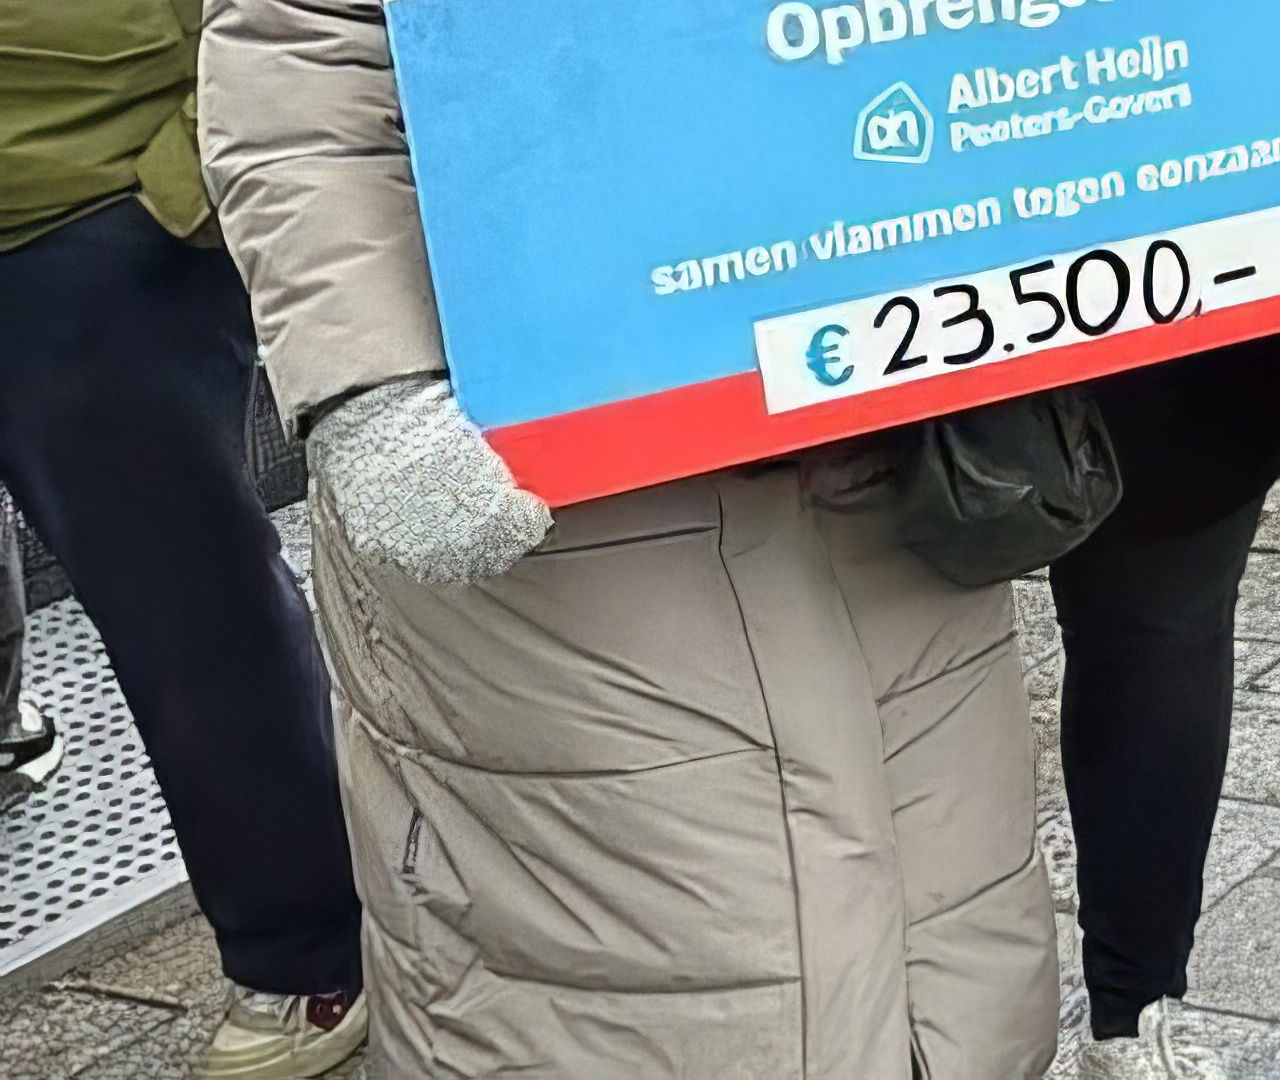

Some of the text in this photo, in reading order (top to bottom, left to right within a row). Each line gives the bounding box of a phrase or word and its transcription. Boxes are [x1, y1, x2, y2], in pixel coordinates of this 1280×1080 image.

[947, 55, 1080, 114] Albert
[650, 238, 798, 296] samen
[808, 195, 1002, 261] vlammen
[1012, 170, 1126, 220] tegen
[804, 323, 856, 387] €
